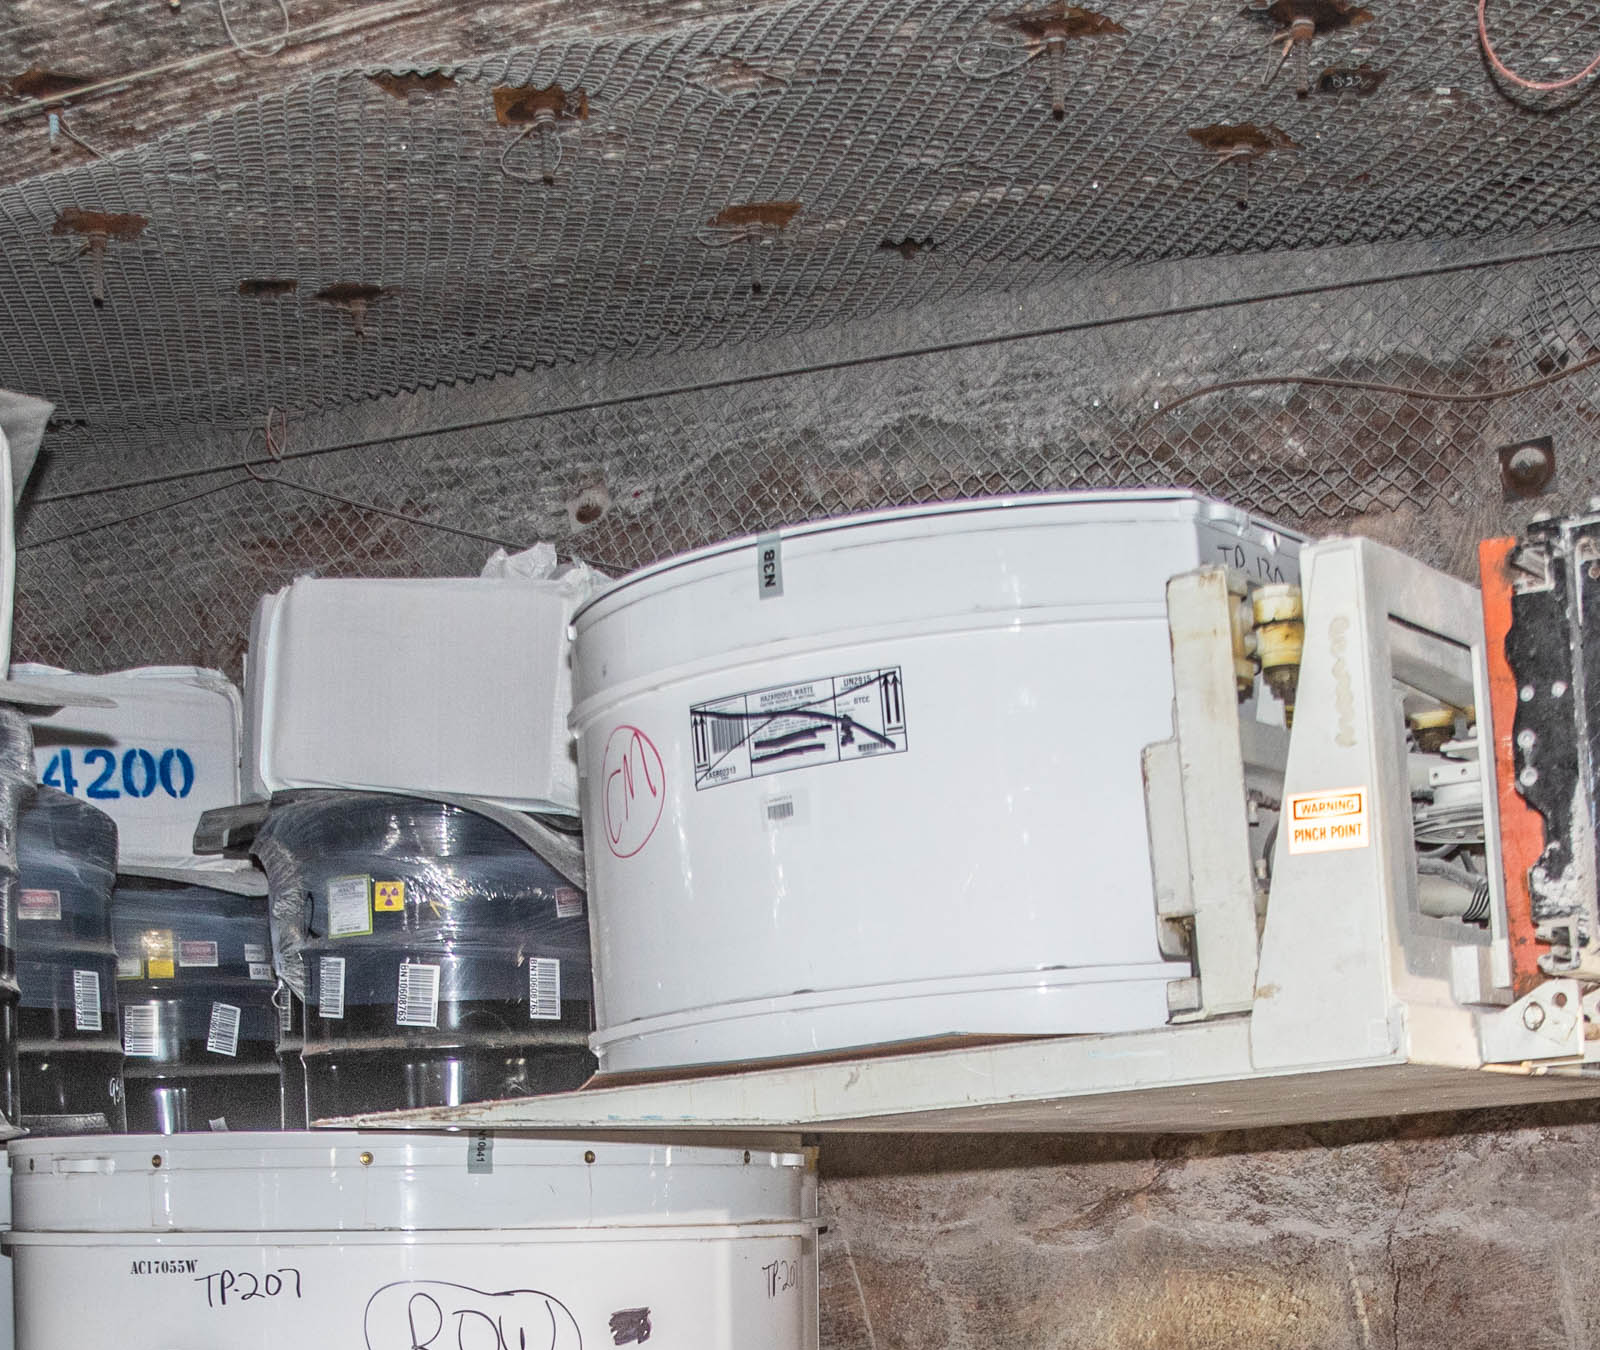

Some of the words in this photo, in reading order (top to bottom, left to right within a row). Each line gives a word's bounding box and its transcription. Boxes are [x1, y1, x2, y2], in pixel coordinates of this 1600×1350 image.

[763, 549, 776, 587] N3B
[42, 747, 195, 799] 4200
[1301, 799, 1355, 816] WARNING
[1293, 826, 1327, 843] PINCH
[1330, 823, 1362, 840] POINT
[396, 963, 410, 1023] BN10608763
[529, 958, 539, 1017] BN10608763
